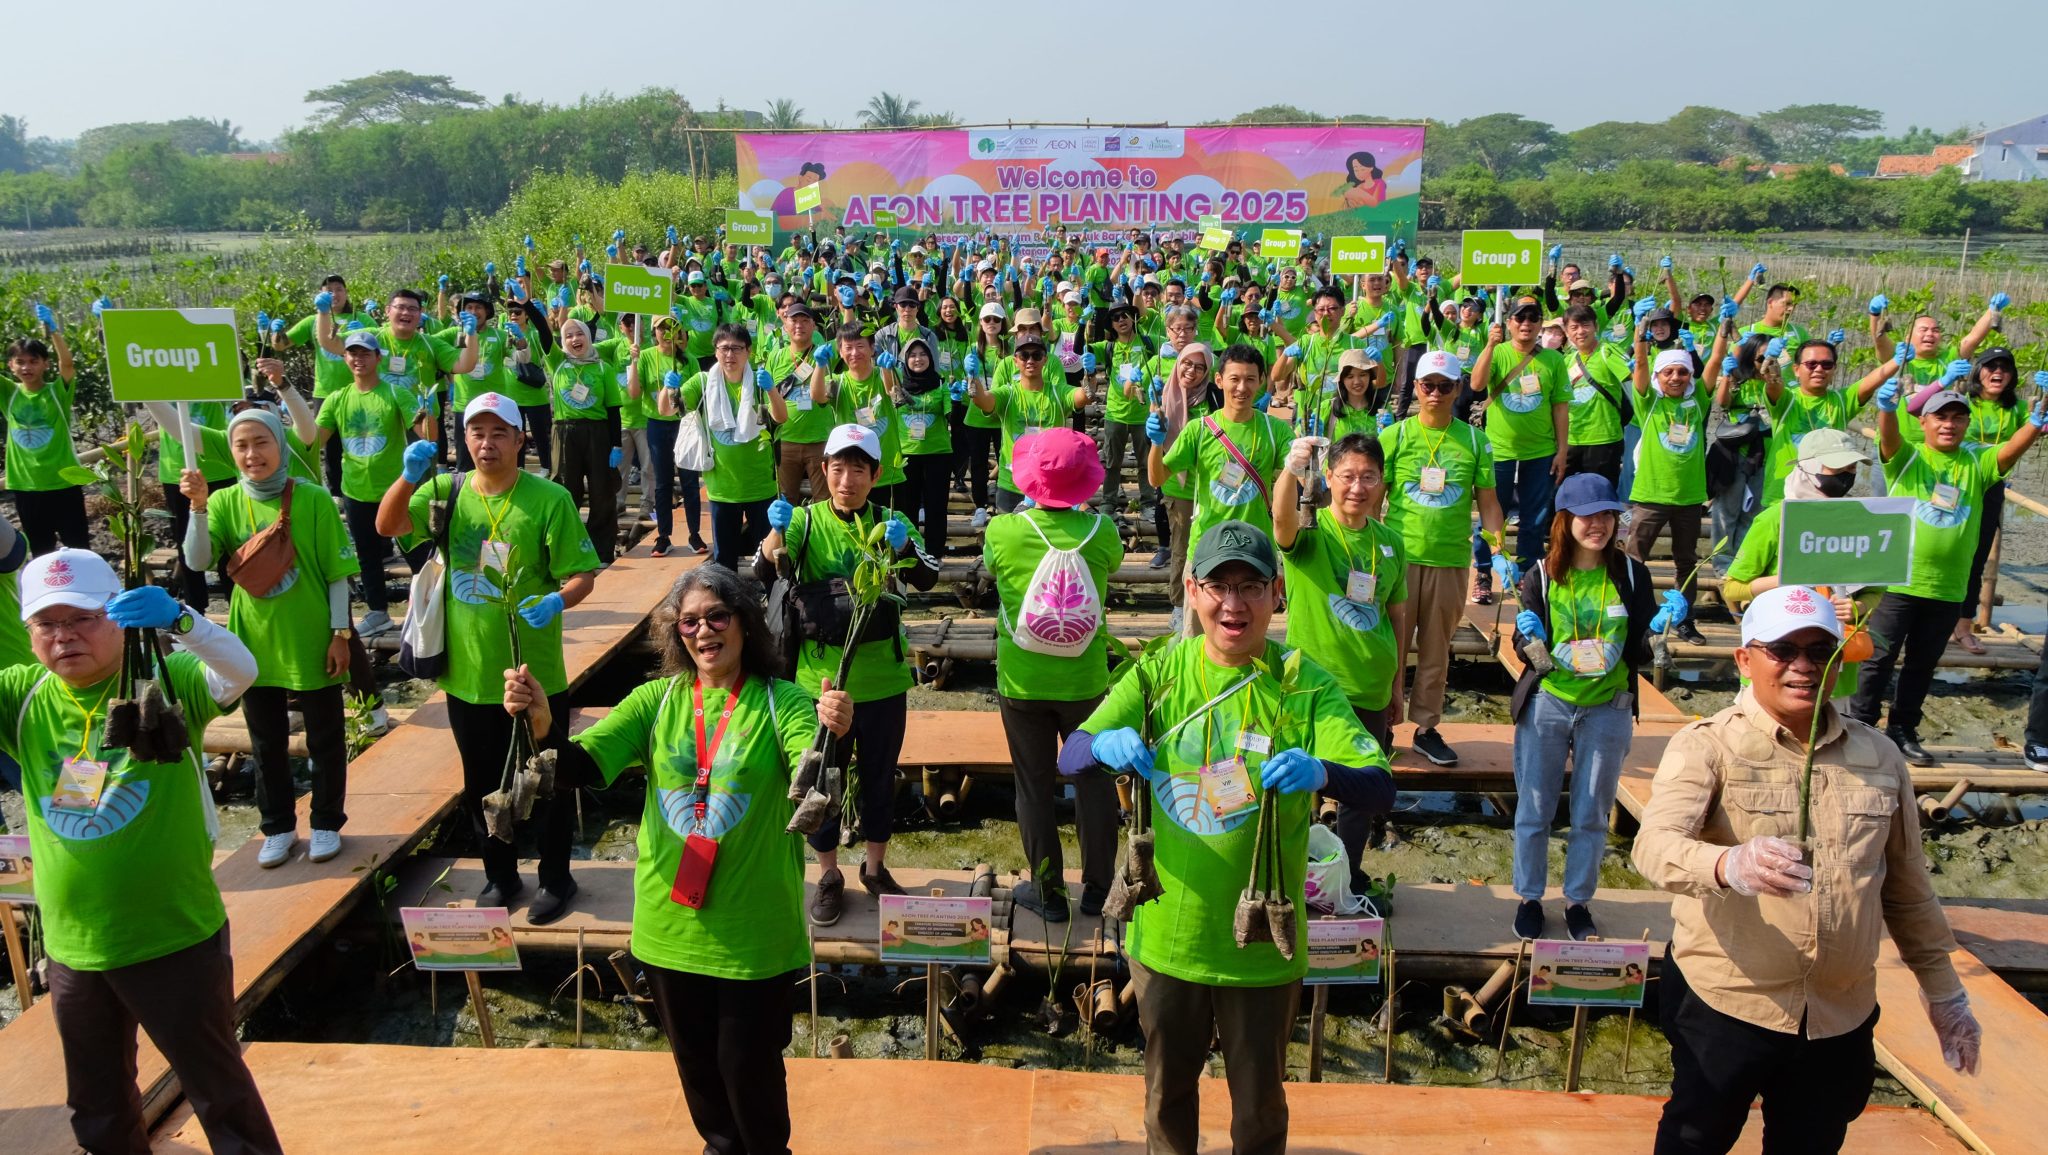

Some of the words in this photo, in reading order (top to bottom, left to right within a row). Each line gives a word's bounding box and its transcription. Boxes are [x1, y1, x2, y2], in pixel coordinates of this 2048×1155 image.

[997, 165, 1122, 189] Welcome
[1129, 165, 1157, 188] to
[950, 193, 1030, 224] TREE
[1040, 191, 1214, 223] PLANTING
[1220, 191, 1309, 223] 2025
[732, 222, 758, 234] Group
[760, 222, 766, 232] 3
[1265, 239, 1286, 248] Group
[1288, 239, 1296, 248] 10
[1337, 251, 1367, 262] Group
[1371, 251, 1377, 260] 9
[1472, 249, 1515, 268] Group
[1520, 249, 1530, 264] 8
[613, 282, 650, 299] Group
[653, 284, 662, 298] 2
[126, 342, 200, 373] Group
[206, 342, 218, 366] 1
[1799, 531, 1871, 558] Group
[1878, 529, 1893, 553] 7
